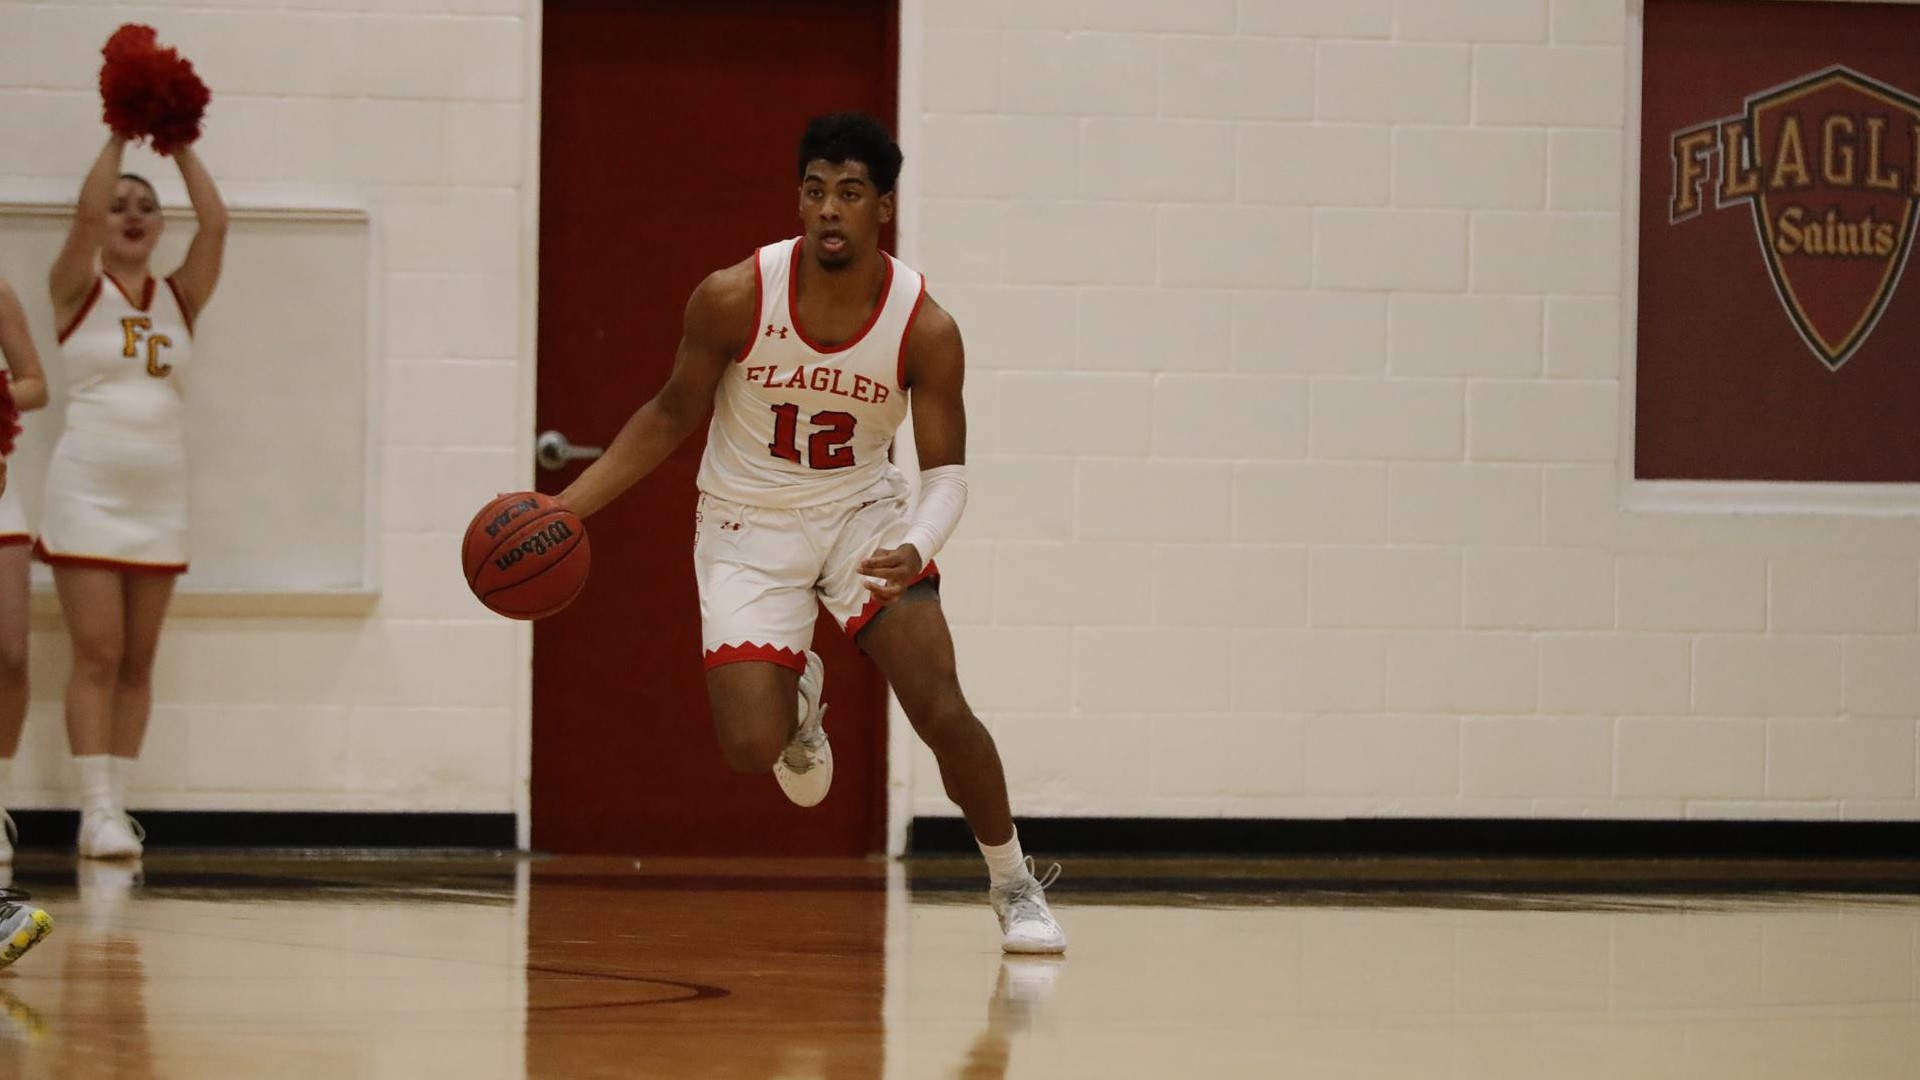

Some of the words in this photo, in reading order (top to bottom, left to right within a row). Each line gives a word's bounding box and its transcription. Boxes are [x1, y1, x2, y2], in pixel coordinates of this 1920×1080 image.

[1676, 113, 1920, 212] FLAGL
[1776, 205, 1896, 257] Saints
[121, 316, 173, 378] FC
[746, 364, 890, 404] FLAGLER
[768, 402, 857, 470] 12
[495, 519, 574, 571] Wilson
